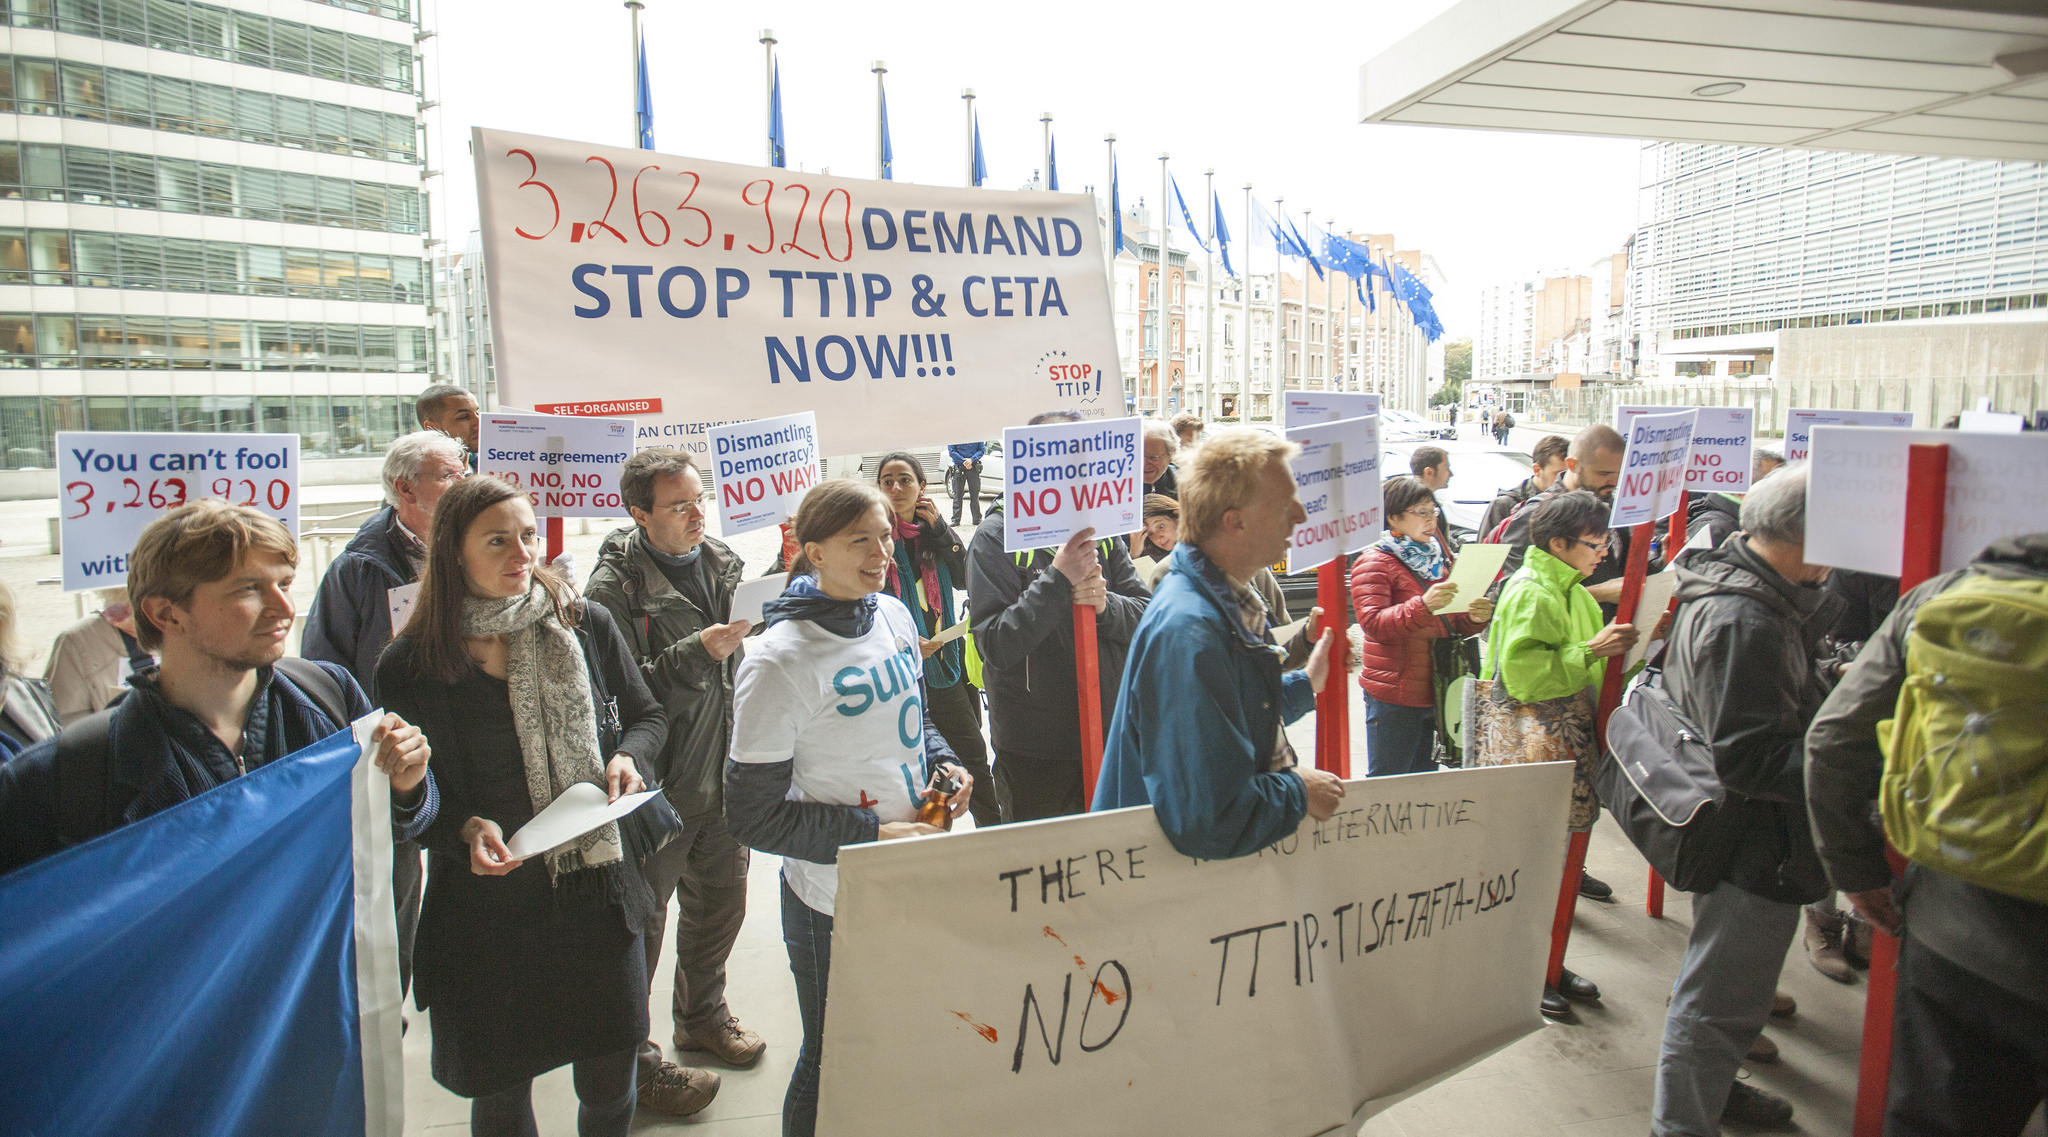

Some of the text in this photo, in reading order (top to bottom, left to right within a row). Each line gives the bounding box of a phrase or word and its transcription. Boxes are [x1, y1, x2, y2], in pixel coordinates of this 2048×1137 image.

[861, 207, 1083, 257] DEMAND
[571, 263, 1069, 319] STOP TTIP & CETA
[764, 333, 956, 384] NOW!!!
[1049, 364, 1092, 381] STOP
[553, 401, 650, 416] SELF-ORGANISED
[716, 424, 813, 455] Dismantling
[1012, 431, 1135, 459] Dismantling
[72, 447, 288, 472] You can't fool
[488, 448, 627, 465] Secret agreement?
[719, 443, 814, 478] Democracy?
[1013, 453, 1135, 485] Democracy?
[1694, 454, 1721, 466] NO
[530, 472, 565, 490] NO,
[572, 474, 602, 488] NO
[723, 464, 817, 508] NO WAY!
[1623, 472, 1653, 498] NO
[1685, 470, 1743, 483] OT GO!
[546, 492, 587, 507] NOT
[1013, 477, 1133, 519] NO WAY!
[1304, 494, 1328, 514] eat?
[1296, 507, 1379, 547] COUNT US OUT!
[999, 845, 1147, 912] THERE
[1312, 799, 1476, 850] ALTERNATIVE
[1012, 960, 1132, 1074] NO
